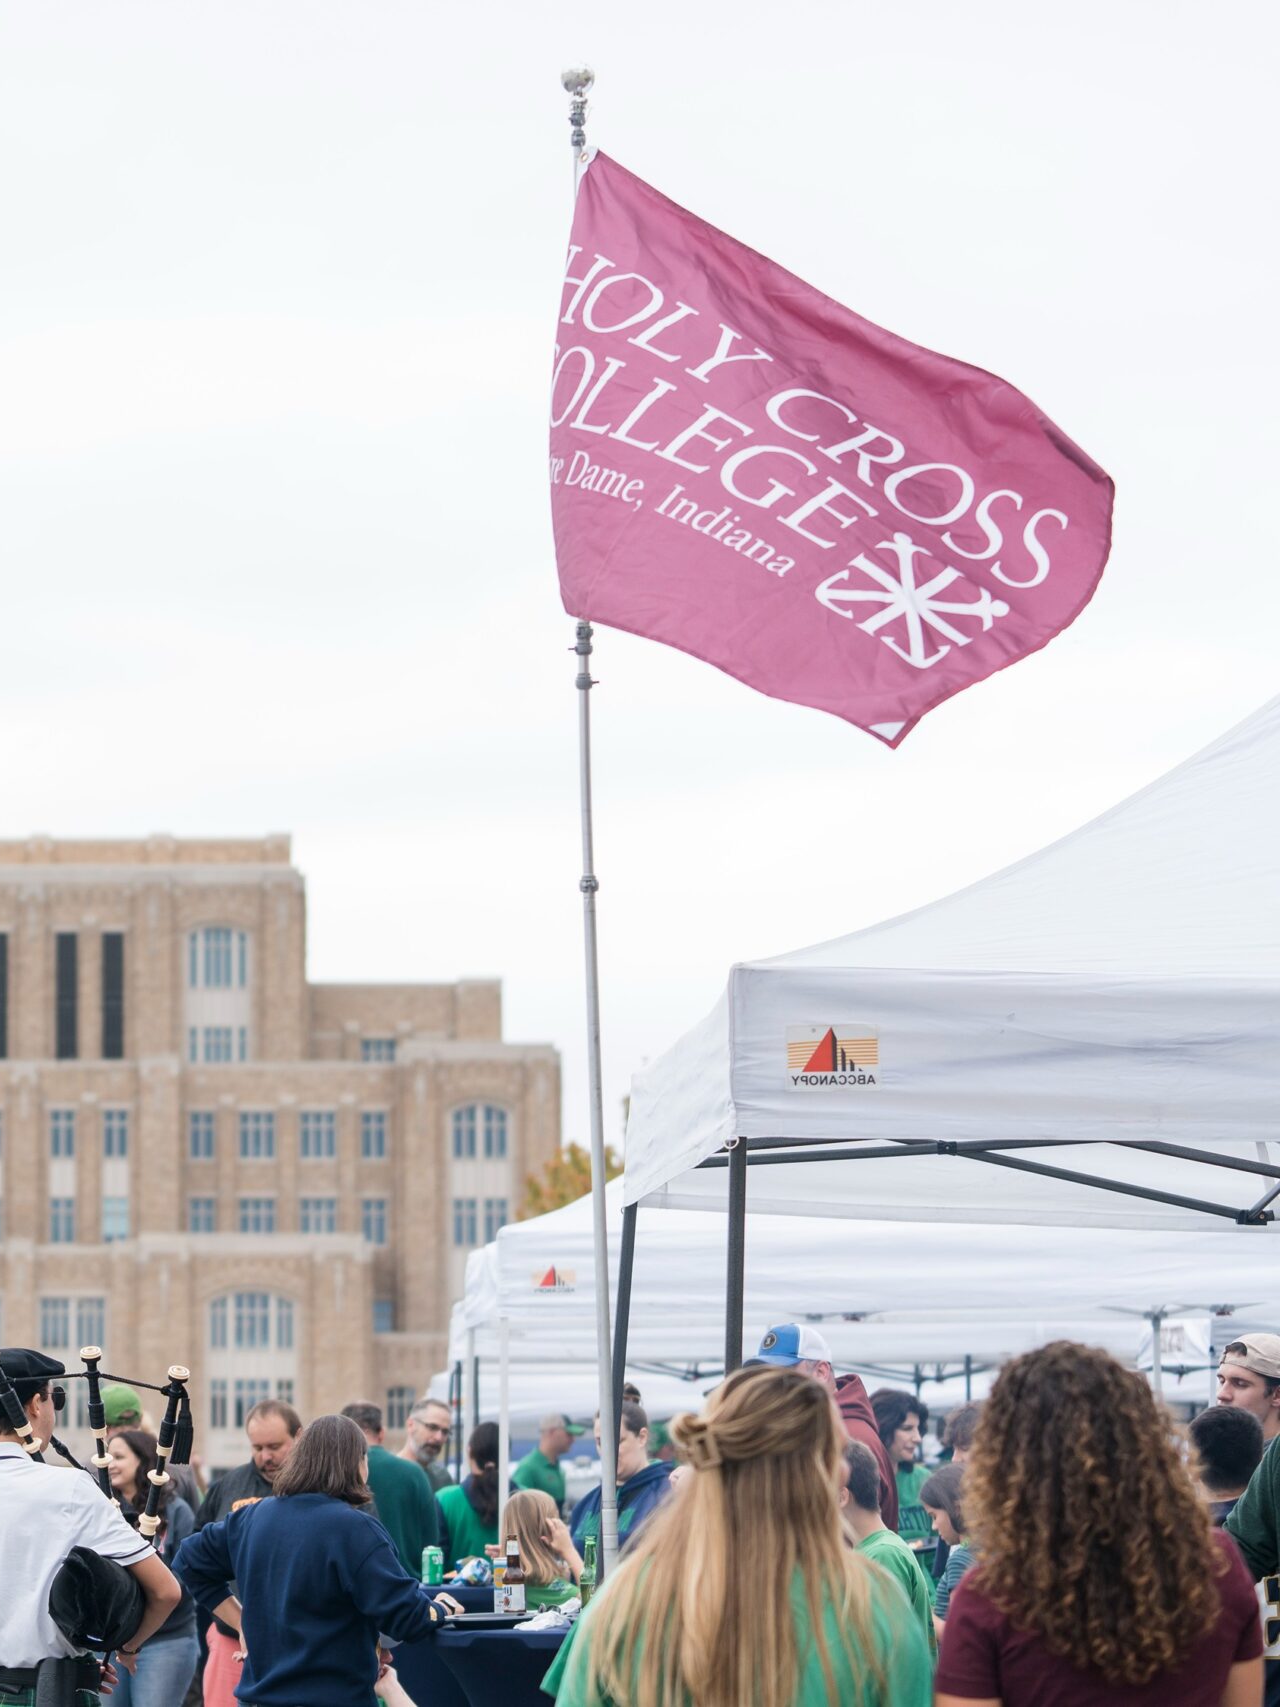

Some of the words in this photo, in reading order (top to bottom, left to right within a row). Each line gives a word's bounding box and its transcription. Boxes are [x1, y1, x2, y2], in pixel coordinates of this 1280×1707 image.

[549, 343, 879, 550] OLLEGE
[560, 244, 773, 384] HOLY
[765, 388, 1069, 588] CROSS
[564, 450, 645, 512] Dame,
[654, 484, 797, 578] Indiana
